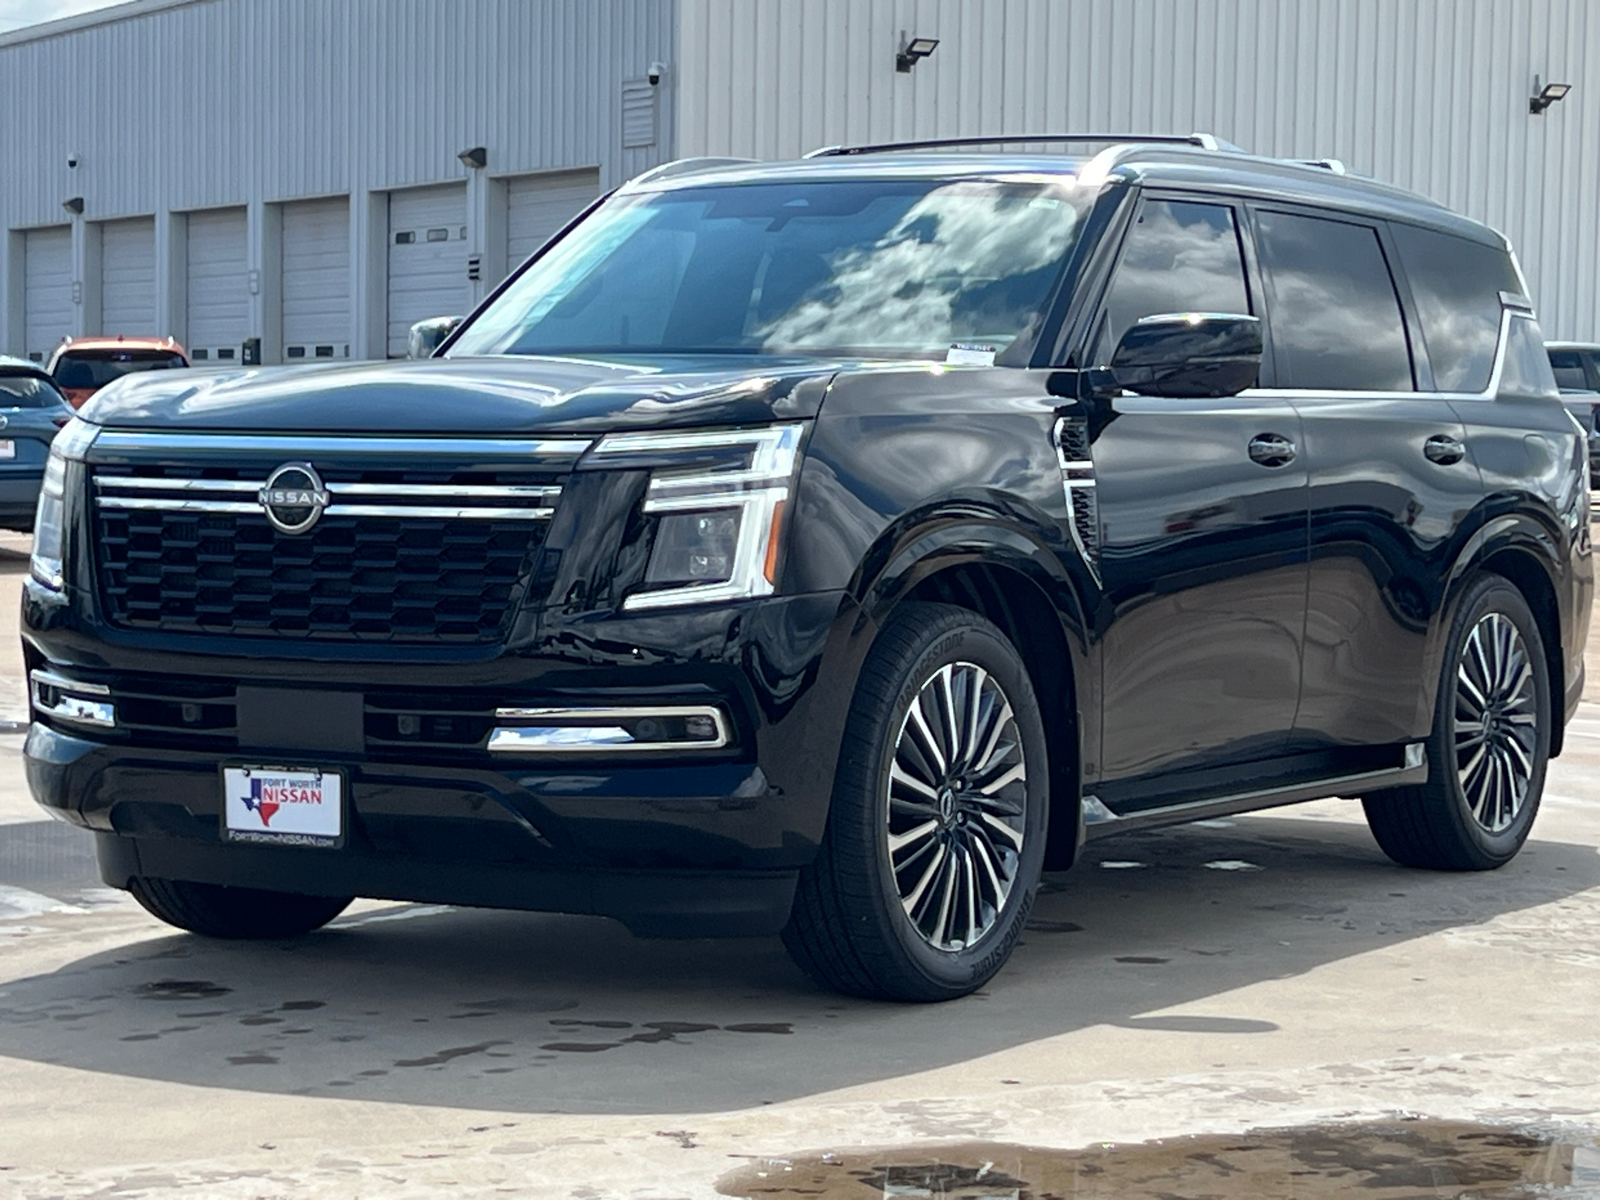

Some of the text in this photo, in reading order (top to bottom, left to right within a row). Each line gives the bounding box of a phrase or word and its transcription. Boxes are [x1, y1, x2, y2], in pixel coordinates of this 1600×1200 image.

[259, 491, 327, 505] NISSAN
[897, 631, 966, 713] BRIDGESTONE
[262, 779, 322, 789] FORT WORTH
[263, 788, 322, 804] NISSAN
[970, 888, 1033, 981] BRIDGESTONE
